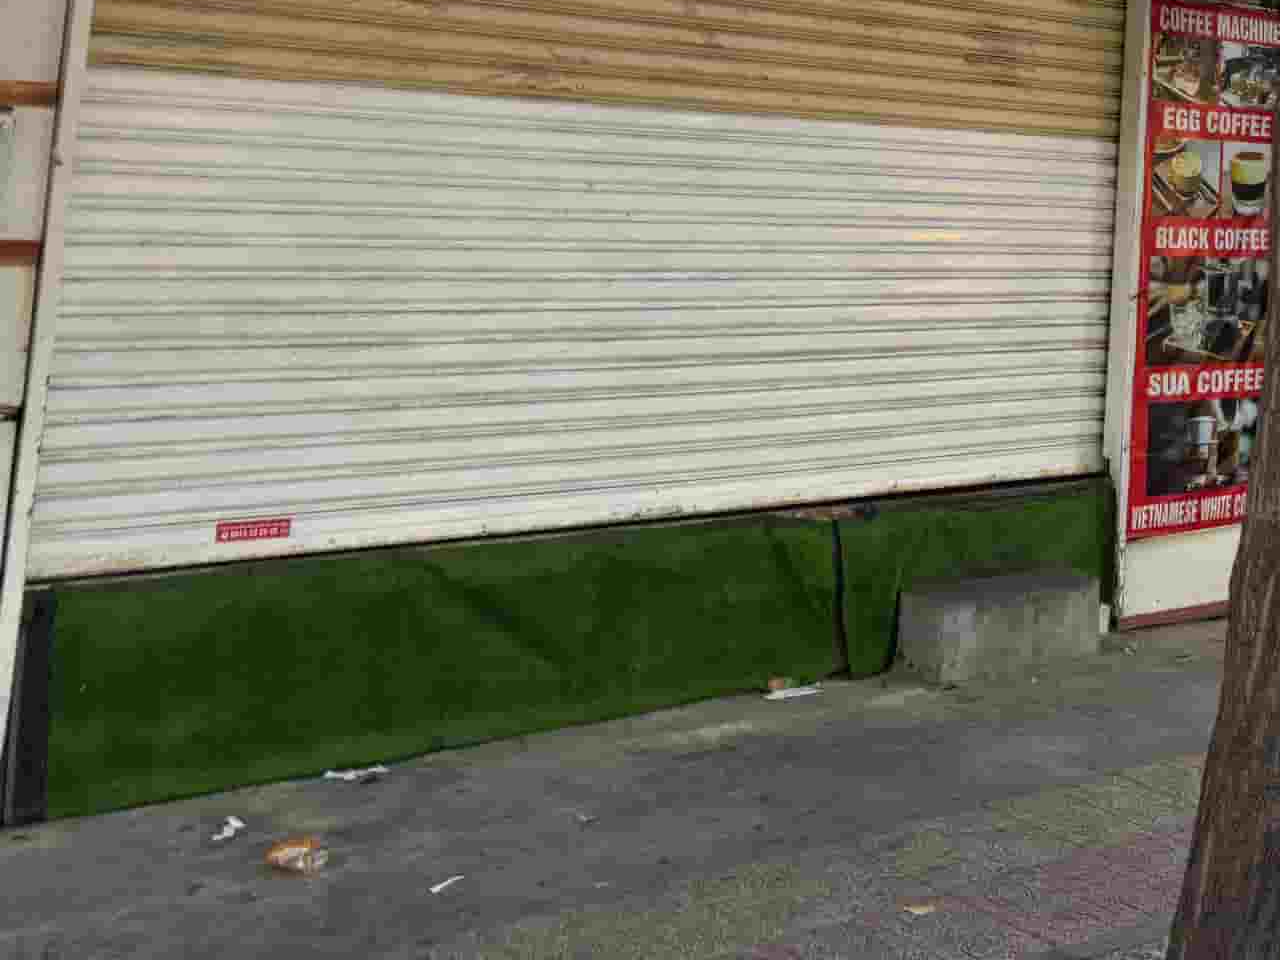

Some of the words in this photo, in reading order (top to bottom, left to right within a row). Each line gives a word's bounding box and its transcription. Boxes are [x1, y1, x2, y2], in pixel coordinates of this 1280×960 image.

[1160, 4, 1212, 32] COFFEE
[1217, 12, 1280, 43] MACHINE
[1163, 107, 1200, 132] EGG
[1206, 110, 1272, 137] COFFEE
[1156, 226, 1209, 250] BLACK
[1215, 227, 1269, 251] COFFEE
[1197, 367, 1264, 394] COFFEE
[1132, 499, 1199, 530] VIETNAMESE
[1200, 495, 1233, 521] WHITE
